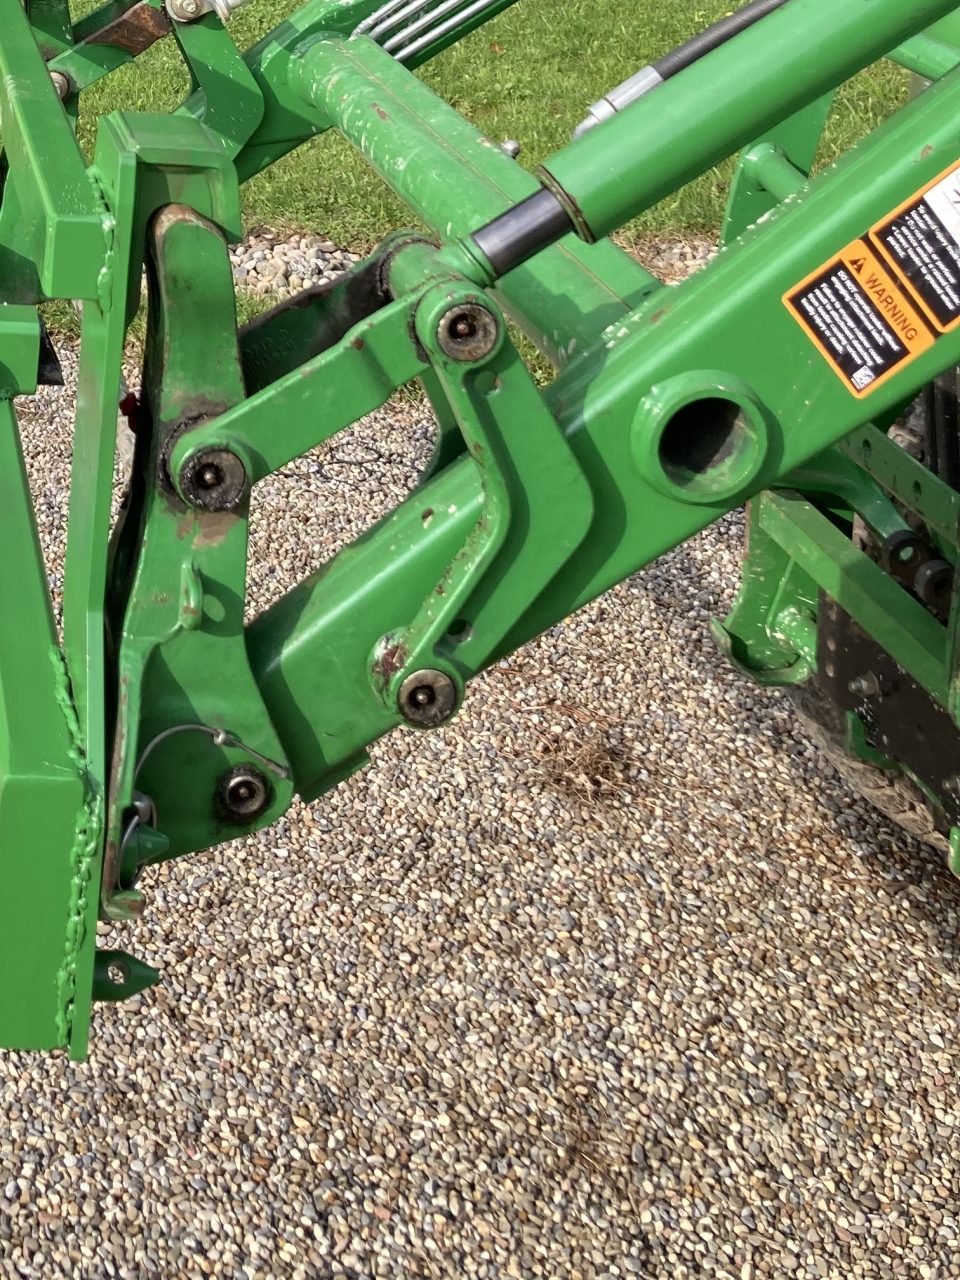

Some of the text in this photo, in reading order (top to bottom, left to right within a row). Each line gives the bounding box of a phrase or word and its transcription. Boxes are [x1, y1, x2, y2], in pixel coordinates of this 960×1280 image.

[837, 270, 847, 280] DO
[844, 279, 857, 293] NOT
[864, 273, 919, 341] WARNING
